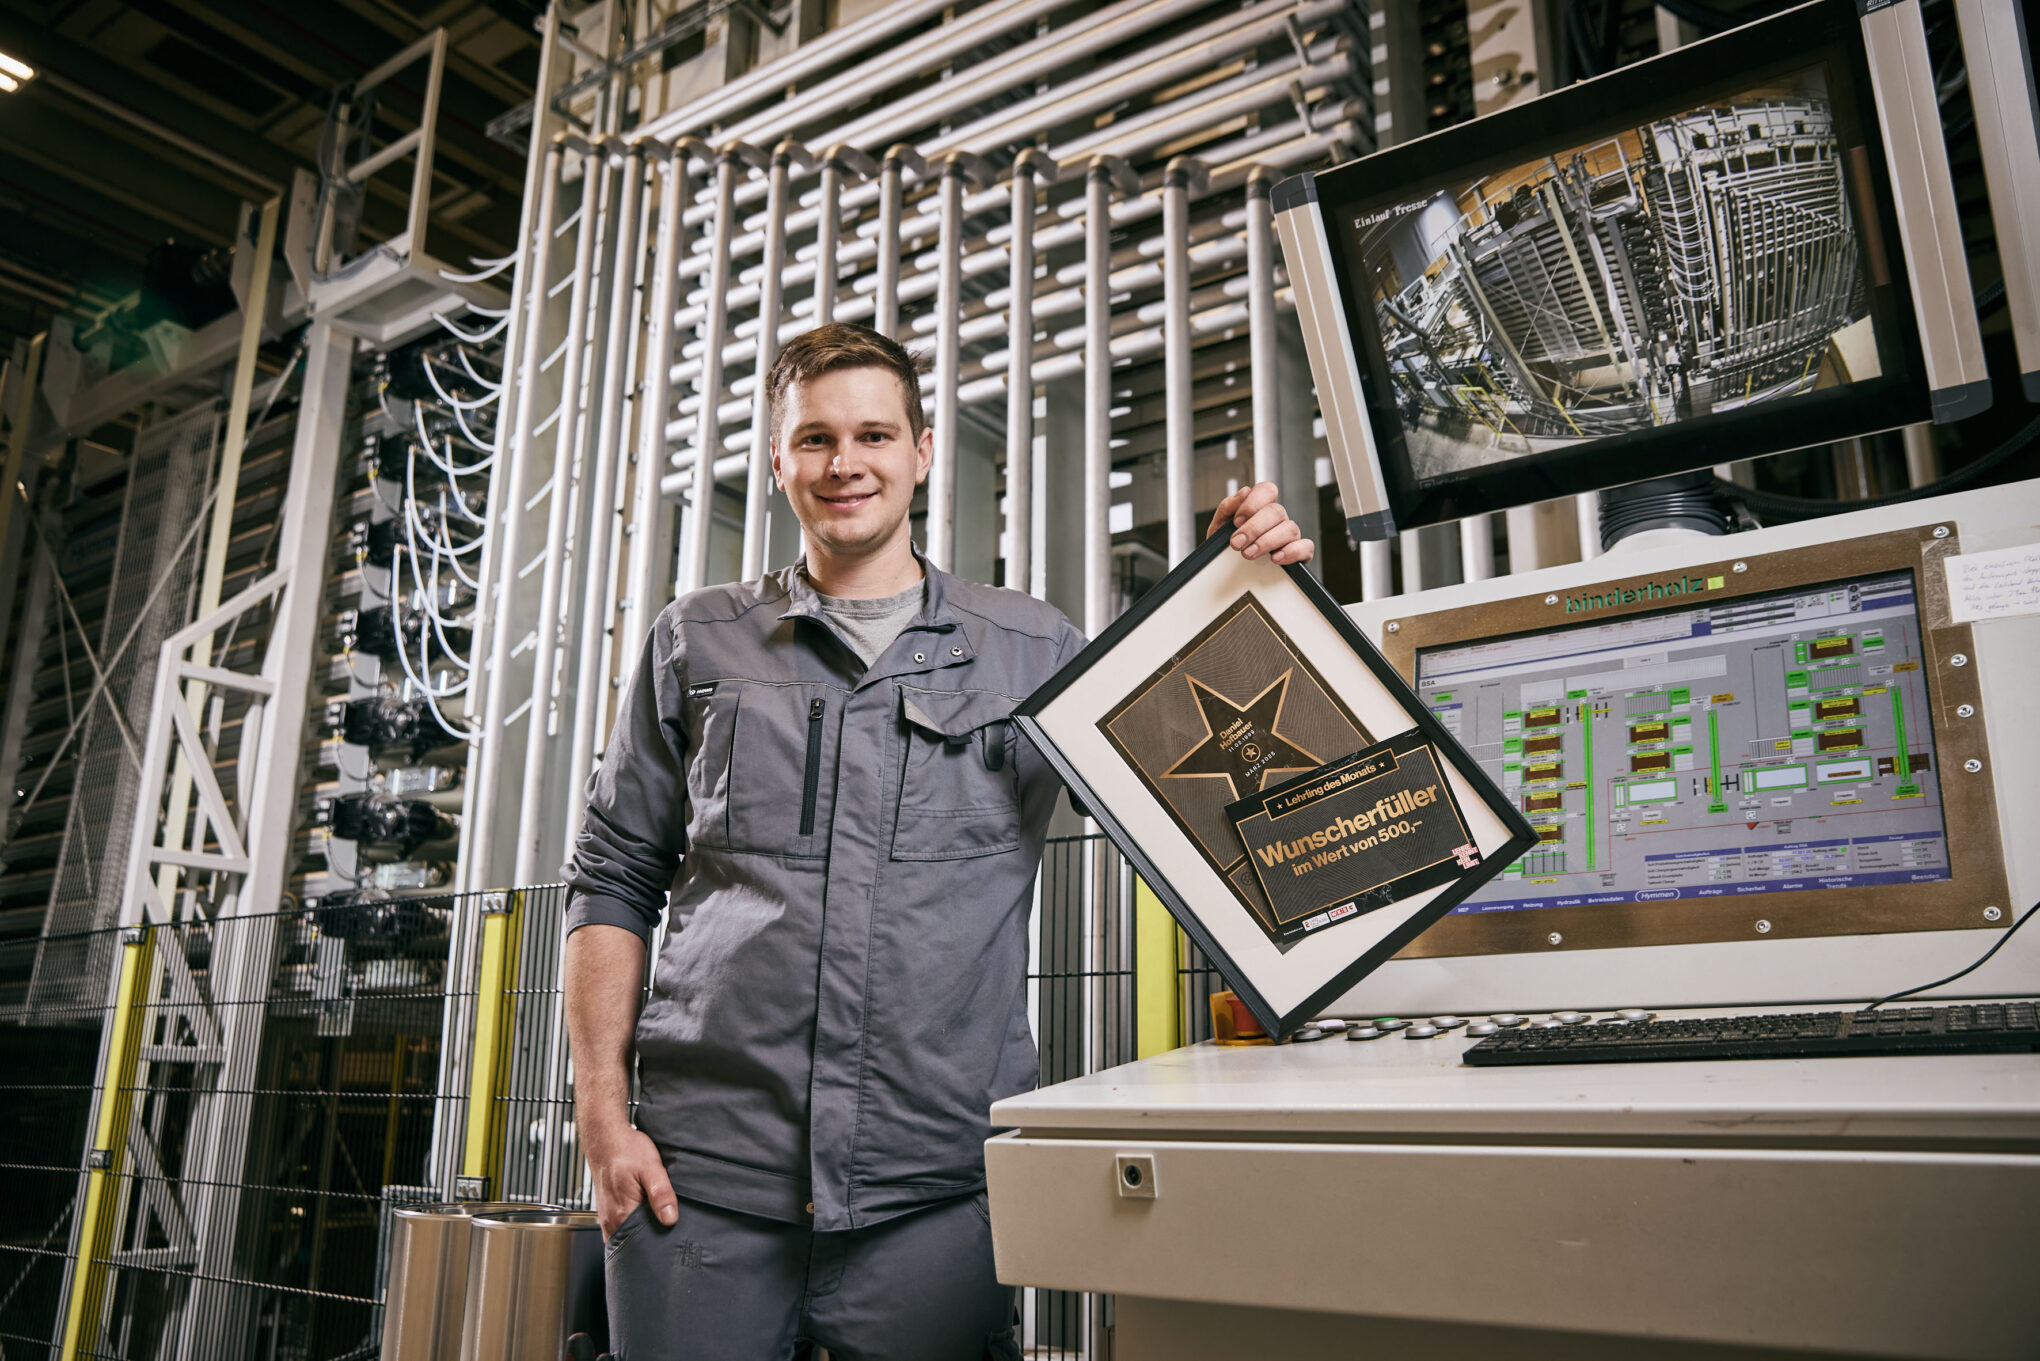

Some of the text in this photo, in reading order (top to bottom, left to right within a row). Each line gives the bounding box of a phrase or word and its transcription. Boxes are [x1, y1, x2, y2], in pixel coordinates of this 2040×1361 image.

[1354, 200, 1428, 229] Einlauf Presse
[1566, 576, 1704, 614] binderholz
[1219, 717, 1244, 740] Daniel
[1219, 720, 1253, 750] Hofbauer
[1228, 729, 1255, 753] 11.02.1999
[1245, 750, 1276, 777] MÄRZ 2025
[1284, 763, 1377, 807] Lehrling des Monats
[1257, 784, 1438, 868] Wunscherfüller
[1292, 861, 1313, 877] im
[1311, 844, 1351, 868] Wert
[1349, 834, 1379, 854] von
[1818, 875, 1853, 883] Historische
[1911, 872, 1940, 881] Beenden
[1587, 895, 1624, 903] Betriebsdaten
[1640, 891, 1674, 900] Hymmen
[1698, 887, 1723, 896] Aufträge
[1737, 885, 1766, 893] Sicherheit
